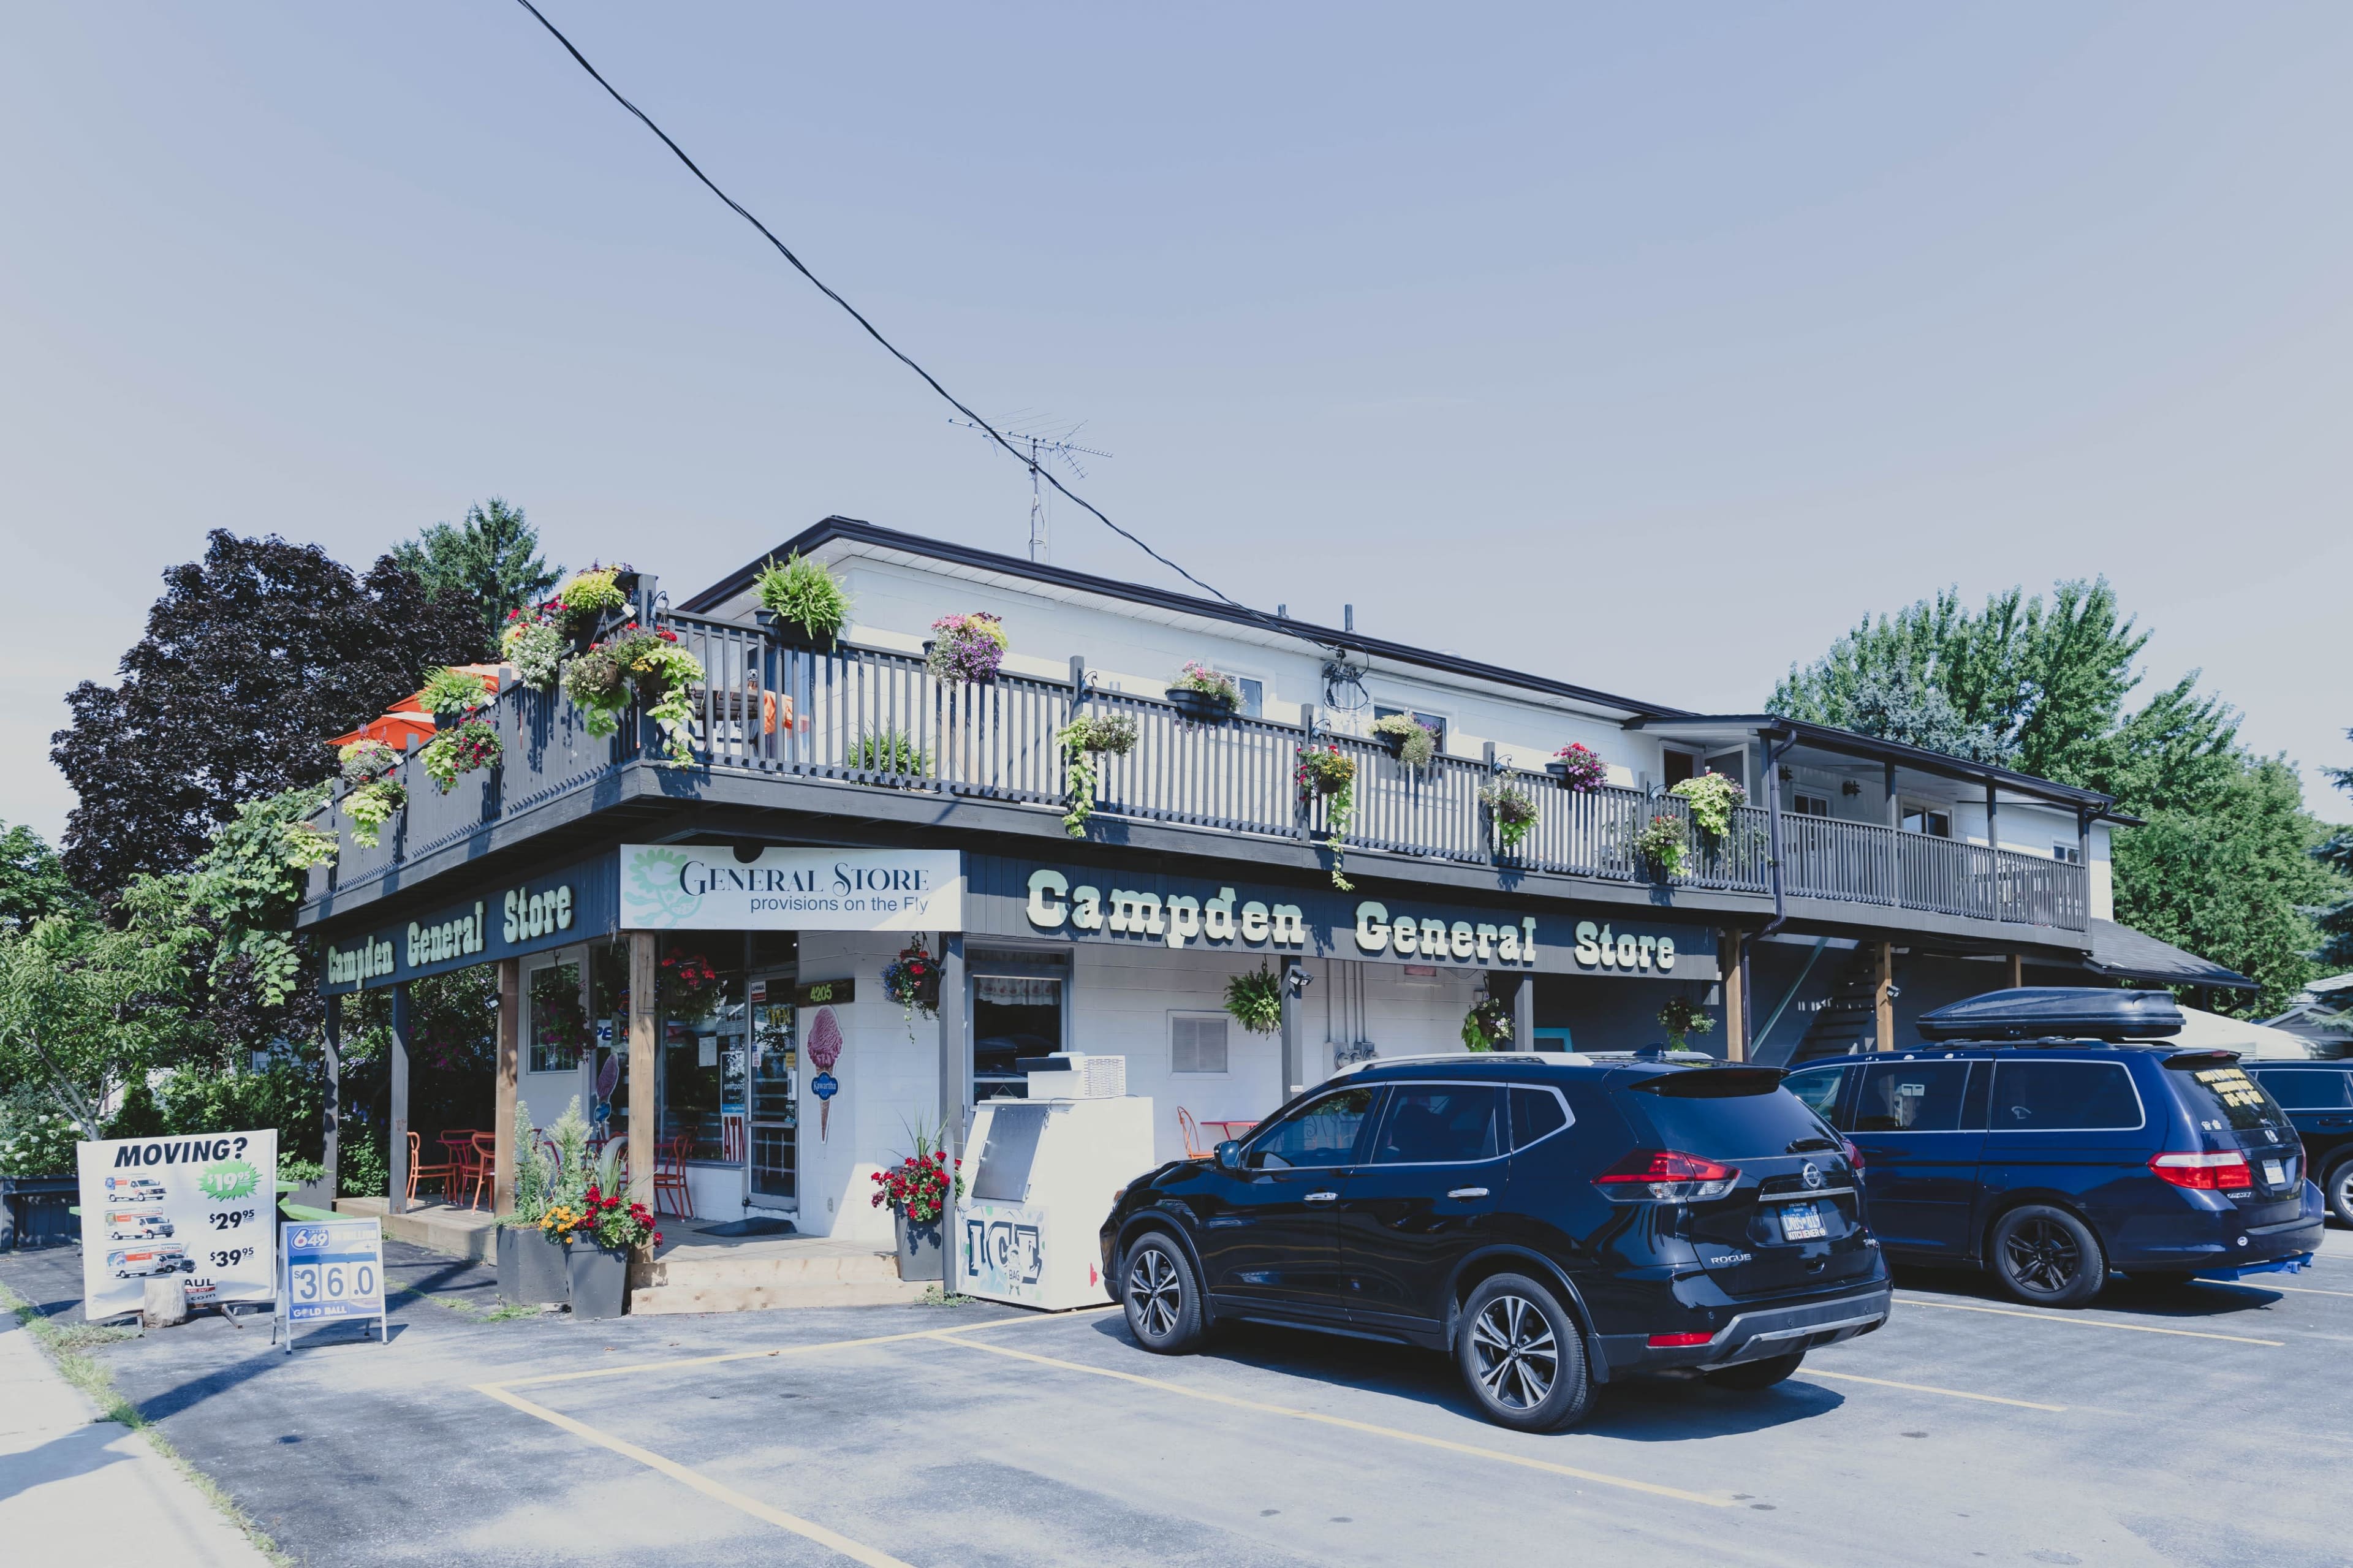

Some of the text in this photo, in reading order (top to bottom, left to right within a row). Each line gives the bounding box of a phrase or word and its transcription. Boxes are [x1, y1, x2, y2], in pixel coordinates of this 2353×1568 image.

[679, 861, 929, 897] GENERAL STORE
[751, 895, 928, 915] provisions on the Fly
[1026, 869, 1675, 970] Campden General Store
[327, 885, 572, 990] Campden General Store
[810, 984, 832, 1002] 4205
[813, 1081, 836, 1091] Kawartha
[114, 1137, 248, 1167] MOVING?
[1711, 1254, 1752, 1264] ROGUE
[185, 1278, 214, 1287] AUL
[1009, 1270, 1020, 1281] BAG
[186, 1293, 216, 1301] .com
